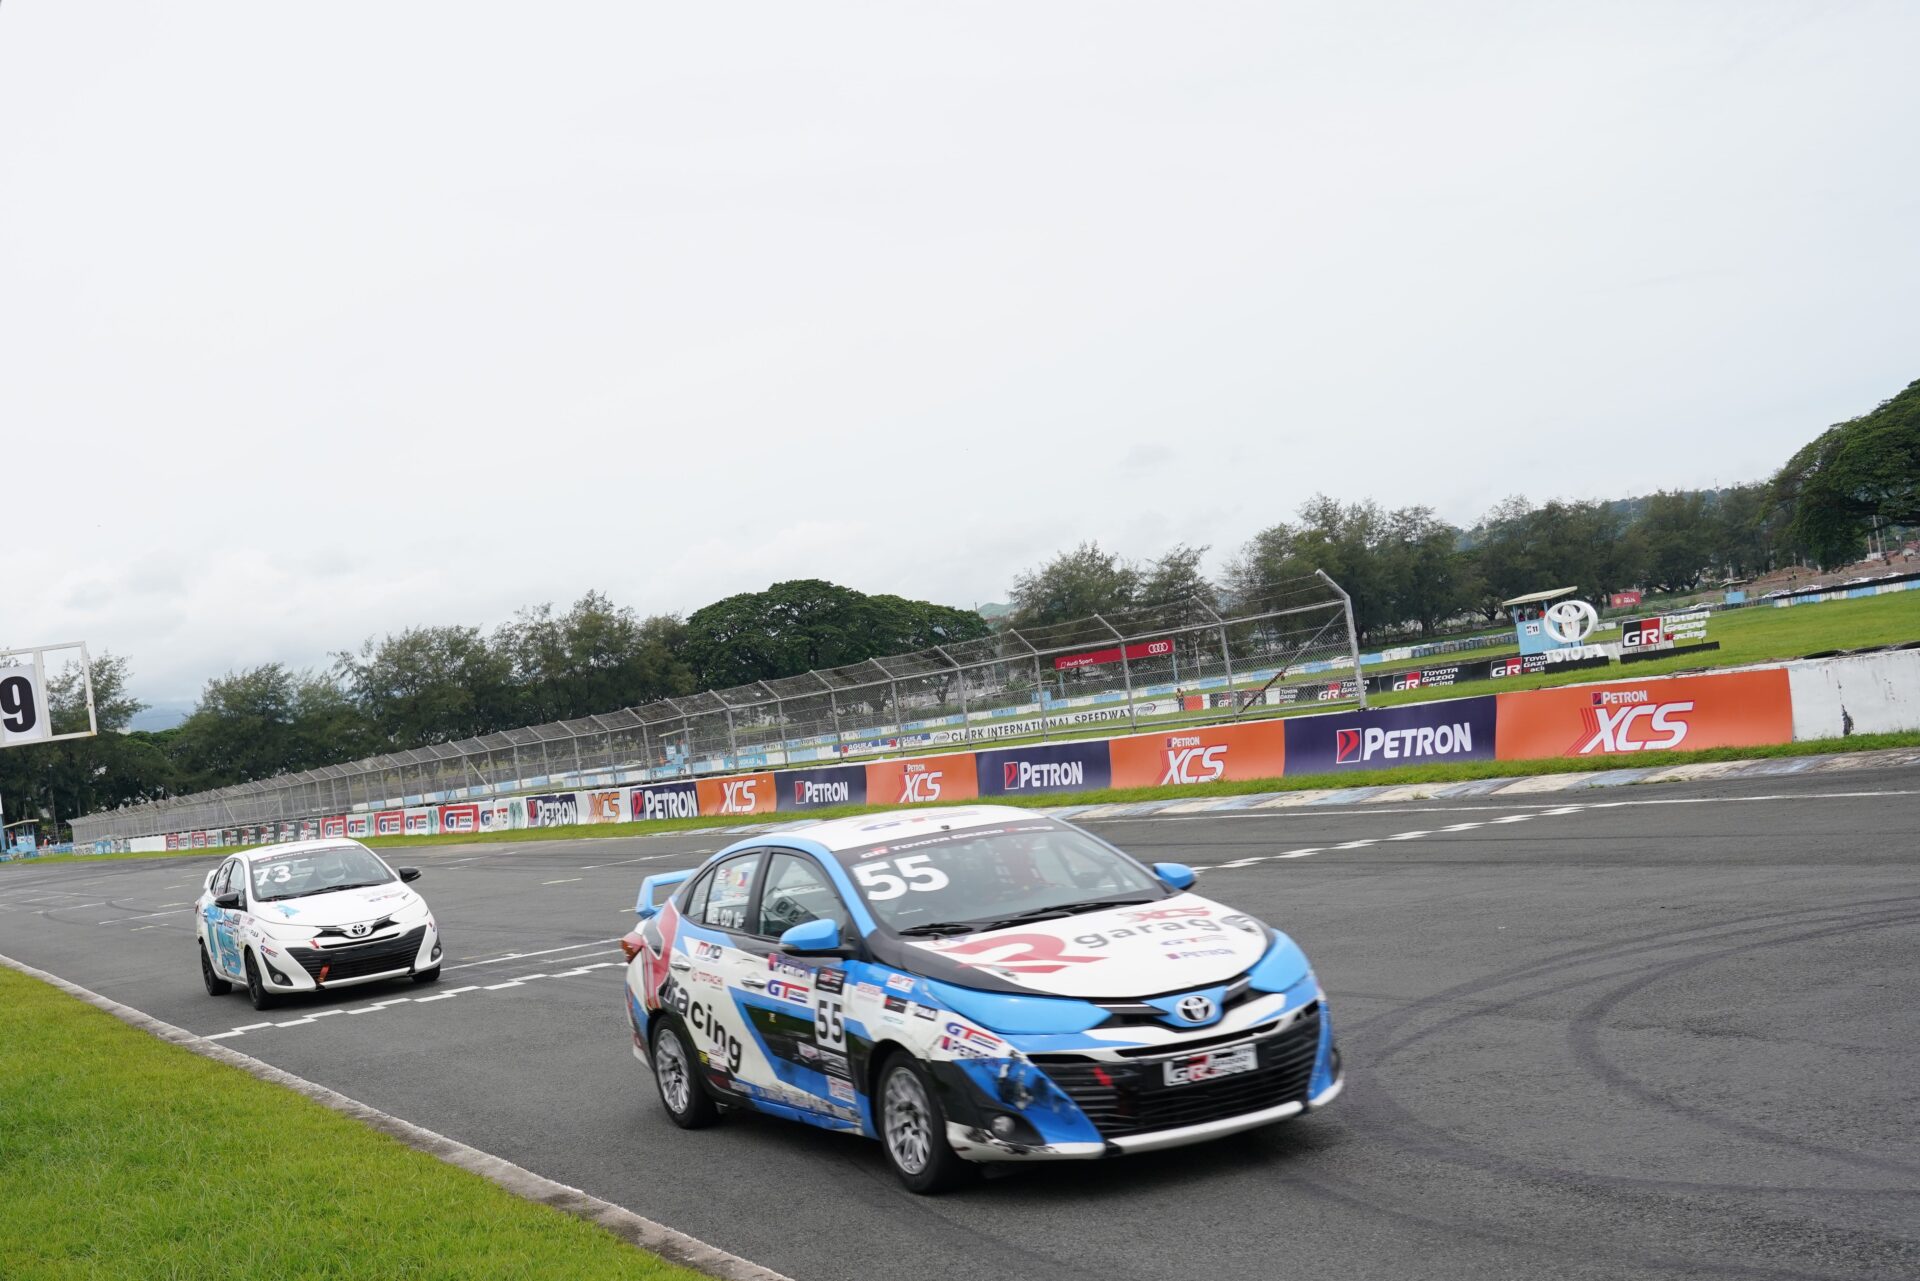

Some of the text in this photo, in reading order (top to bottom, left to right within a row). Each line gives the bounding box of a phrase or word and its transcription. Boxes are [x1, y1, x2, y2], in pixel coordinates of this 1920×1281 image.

[1623, 628, 1660, 647] GR
[1421, 674, 1455, 683] GAZOO
[1422, 667, 1459, 676] TOYOTA
[1491, 664, 1521, 677] GR
[1318, 690, 1339, 700] GR
[1393, 679, 1419, 691] GR
[1, 676, 37, 733] 9
[1603, 690, 1647, 704] PETRON
[1579, 701, 1695, 753] XCS
[1172, 736, 1200, 747] PETRON
[1363, 722, 1472, 760] PETRON
[1020, 761, 1082, 787] PETRON
[1160, 745, 1228, 785] XCS
[721, 780, 756, 813] XCS
[805, 781, 848, 803] PETRON
[899, 771, 942, 803] XCS
[537, 799, 576, 827] PETRON
[590, 792, 620, 822] XCS
[644, 790, 698, 819] PETRON
[446, 812, 472, 829] GT
[890, 837, 950, 851] TOYOTA
[253, 865, 292, 886] 73
[852, 854, 949, 900] 55
[768, 979, 809, 998] GT
[818, 1000, 842, 1044] 55
